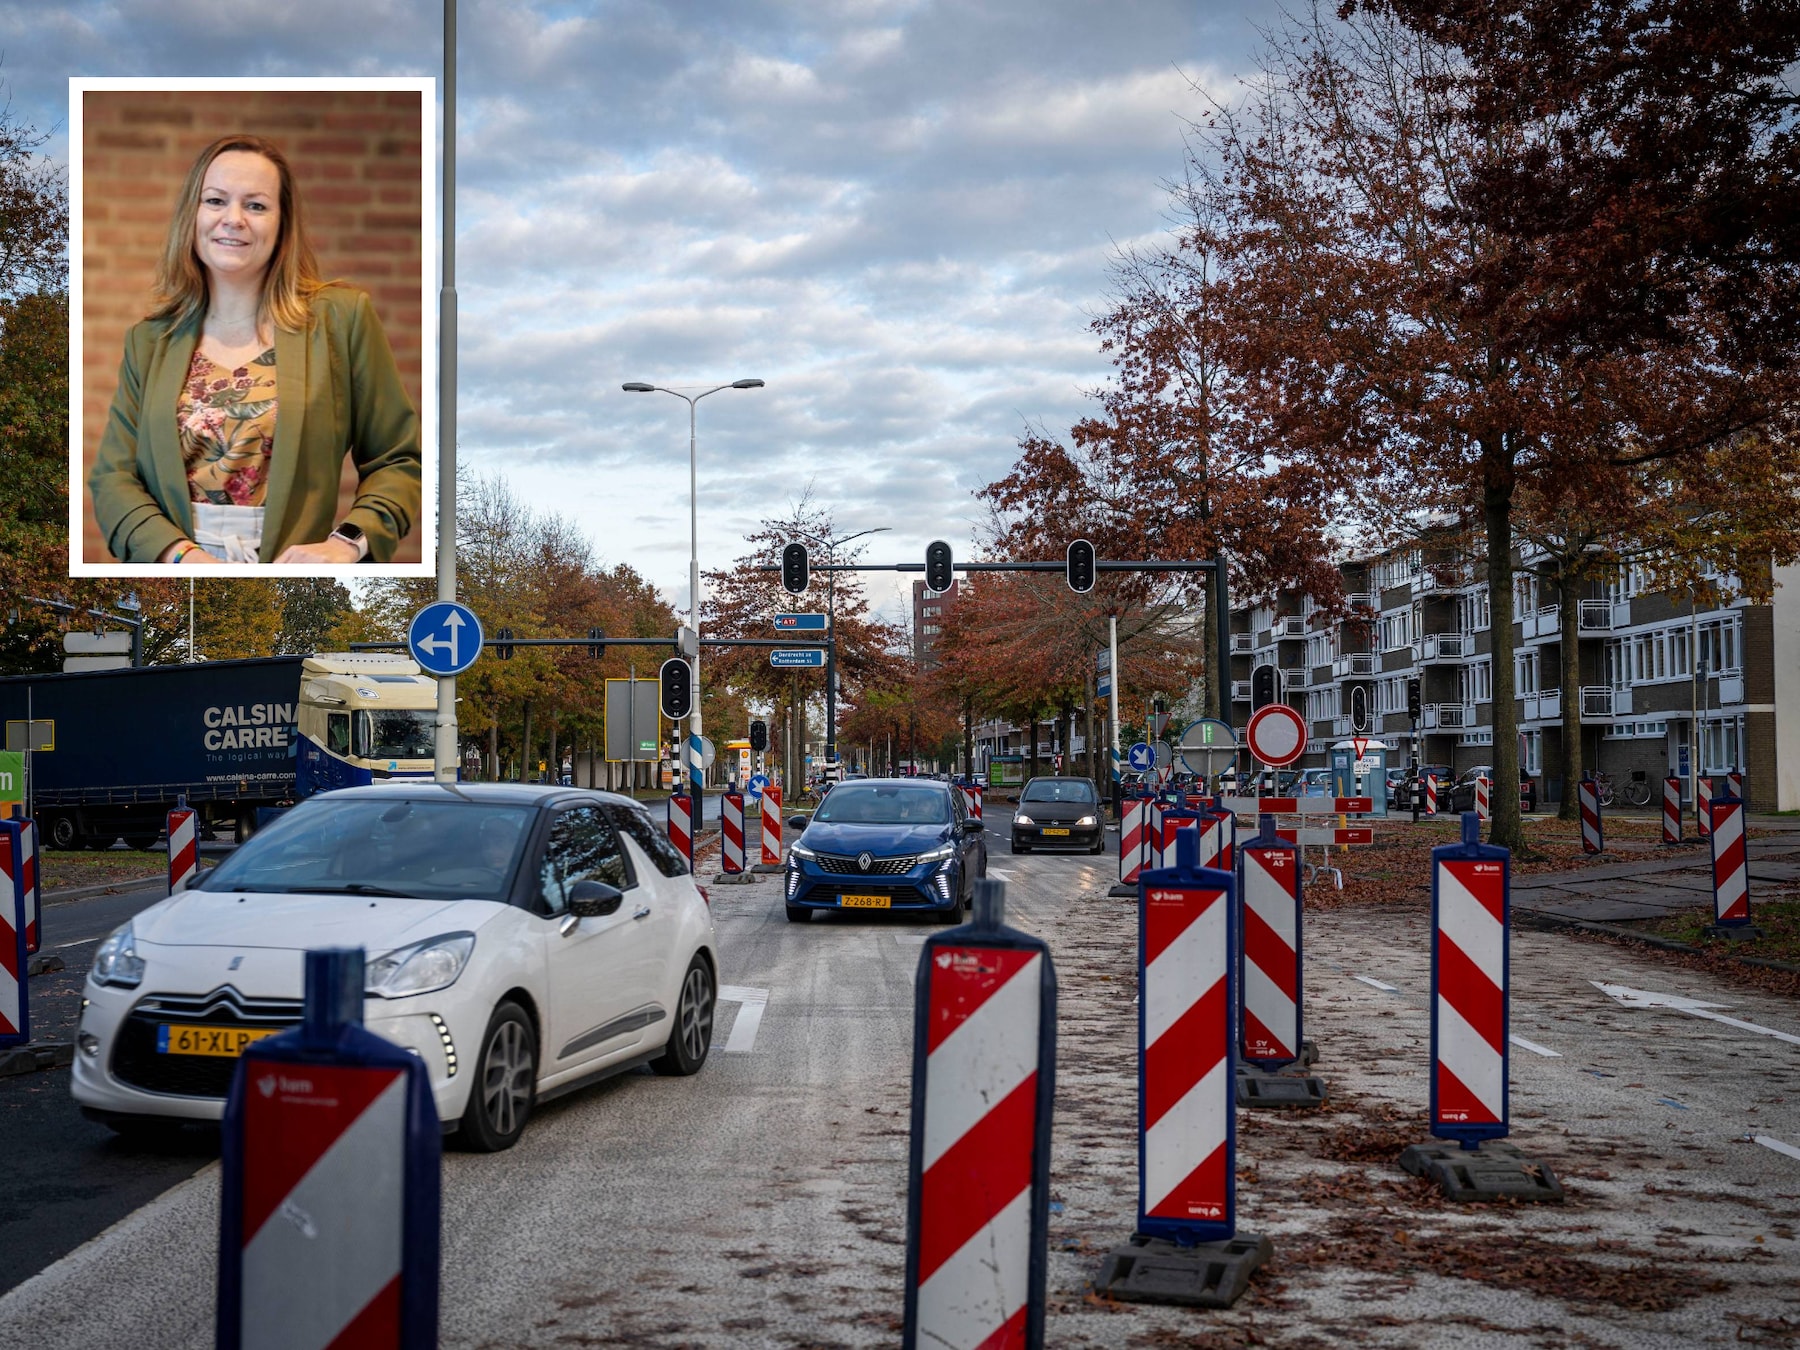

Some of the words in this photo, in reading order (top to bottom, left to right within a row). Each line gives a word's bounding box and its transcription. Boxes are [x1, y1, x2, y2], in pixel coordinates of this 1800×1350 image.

[203, 726, 288, 751] CARRE
[206, 753, 223, 762] The
[228, 752, 262, 762] logical
[267, 752, 286, 760] way
[206, 772, 297, 782] www.calsina-carre.com
[1163, 891, 1184, 901] bam
[845, 897, 887, 907] Z-268-RJ
